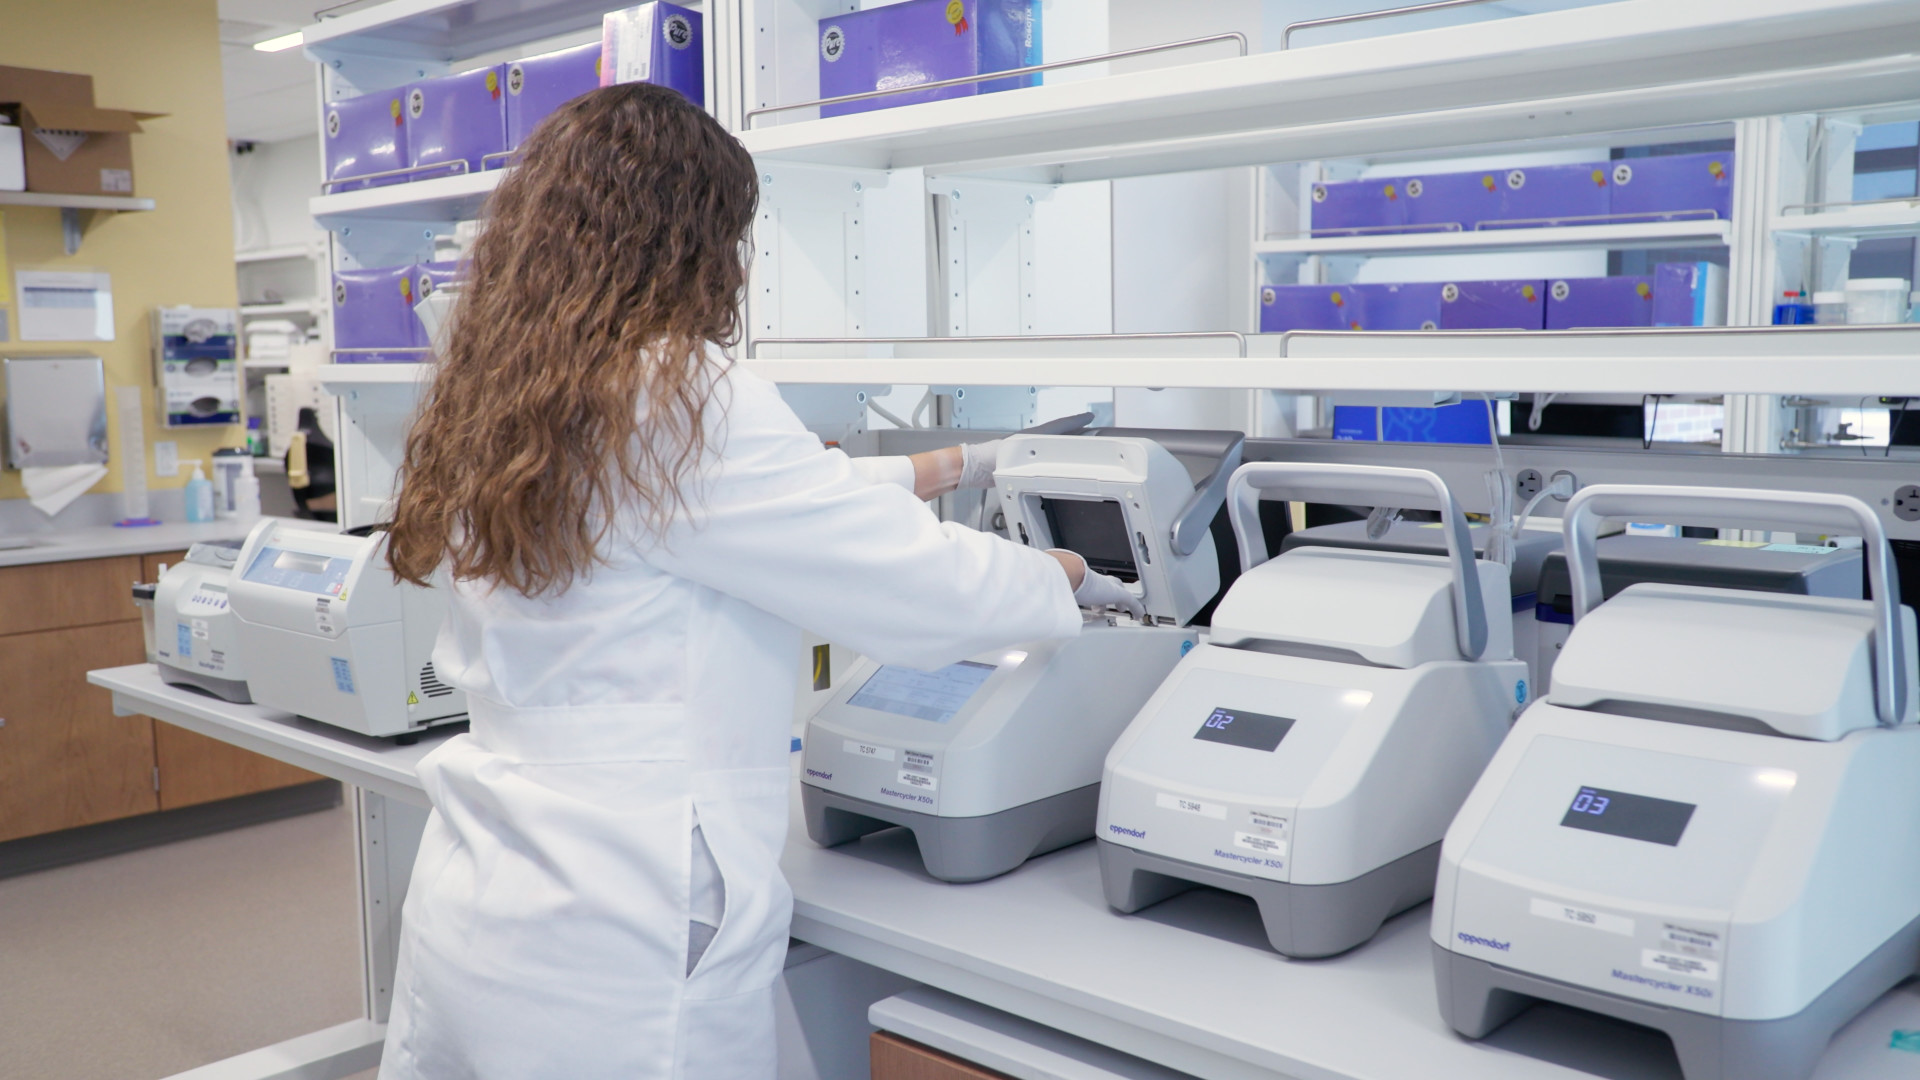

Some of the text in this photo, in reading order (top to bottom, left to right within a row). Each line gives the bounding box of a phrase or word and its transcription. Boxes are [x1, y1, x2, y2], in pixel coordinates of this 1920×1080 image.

[1205, 713, 1235, 729] 02
[806, 768, 832, 781] eppendorf
[880, 787, 917, 801] Mastercycler
[1572, 793, 1610, 815] 03
[1109, 824, 1146, 839] eppendorf
[1213, 848, 1263, 865] Mastercycler
[1457, 932, 1511, 952] eppendorf
[1611, 968, 1683, 992] Mastercycler
